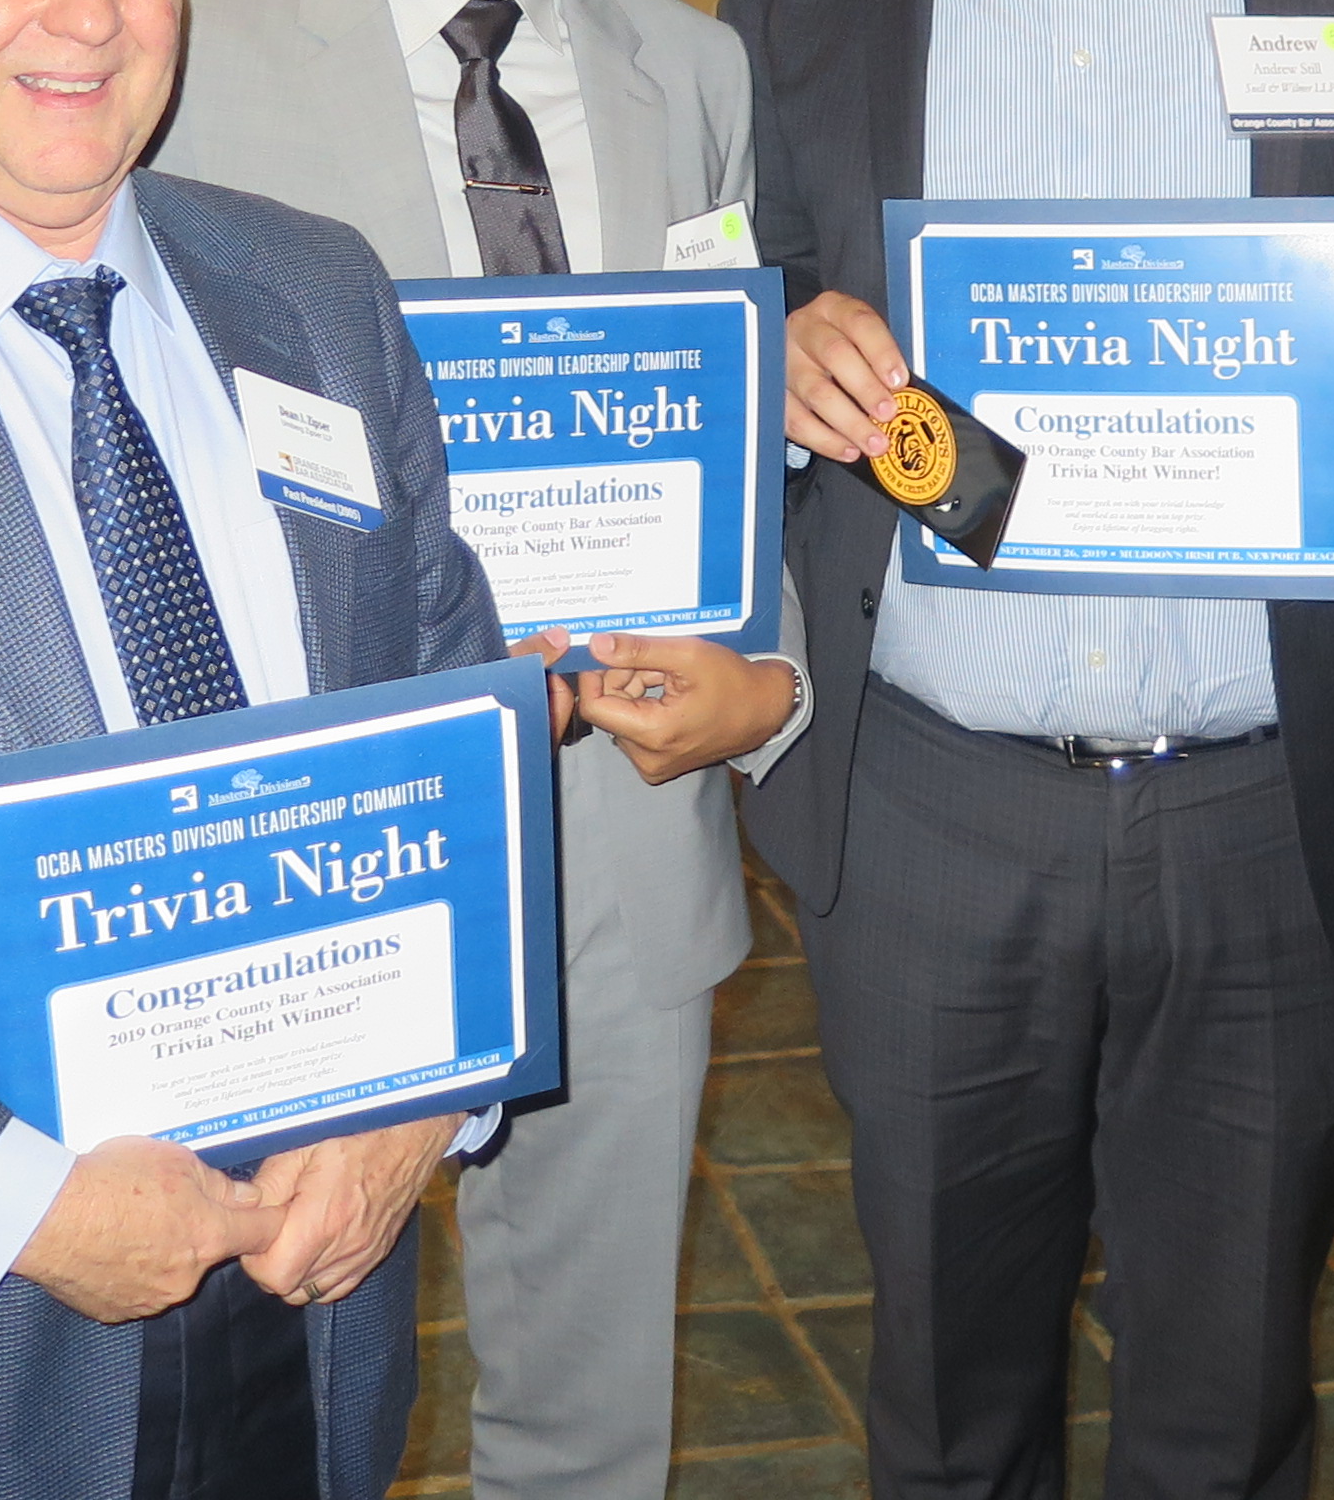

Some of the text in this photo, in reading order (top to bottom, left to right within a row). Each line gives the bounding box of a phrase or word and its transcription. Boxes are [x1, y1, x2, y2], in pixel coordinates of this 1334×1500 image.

[1249, 34, 1319, 52] Andrew
[1253, 62, 1297, 76] Andrew
[674, 237, 715, 262] Arjun
[969, 281, 1294, 303] OCBA MASTERS DIVISION LEADERSHIP COMMITTEE
[437, 358, 496, 381] MASTERS
[499, 355, 554, 378] DIVISION
[557, 352, 631, 376] LEADERSHIP
[633, 349, 702, 373] COMMITTEE
[970, 317, 1298, 380] Trivia Night
[432, 385, 704, 449] rivia Night
[1013, 406, 1255, 440] Congratulations
[1048, 444, 1254, 460] Orange County Bar Association
[1048, 463, 1220, 481] Trivia Night Winner!
[448, 473, 663, 521] Congratulations
[471, 511, 663, 538] Orange County Bar Association
[523, 537, 565, 557] Night
[569, 532, 631, 551] Winner!
[36, 775, 444, 880] OCBA MASTERS DIVISION LEADERSHIP COMMITTEE
[39, 825, 450, 953] Trivia Night
[105, 934, 401, 1020] Congratulations
[108, 969, 400, 1049] 2019 Orange County Bar Association
[155, 995, 361, 1060] Trivia Night Winner!
[172, 1129, 194, 1143] 26,
[196, 1119, 228, 1136] 2019
[242, 1097, 319, 1123] MULDOON'S
[321, 1087, 357, 1105] IRISH
[359, 1080, 391, 1096] PUB,
[392, 1063, 456, 1086] NEWPORT
[457, 1052, 500, 1072] BEACH
